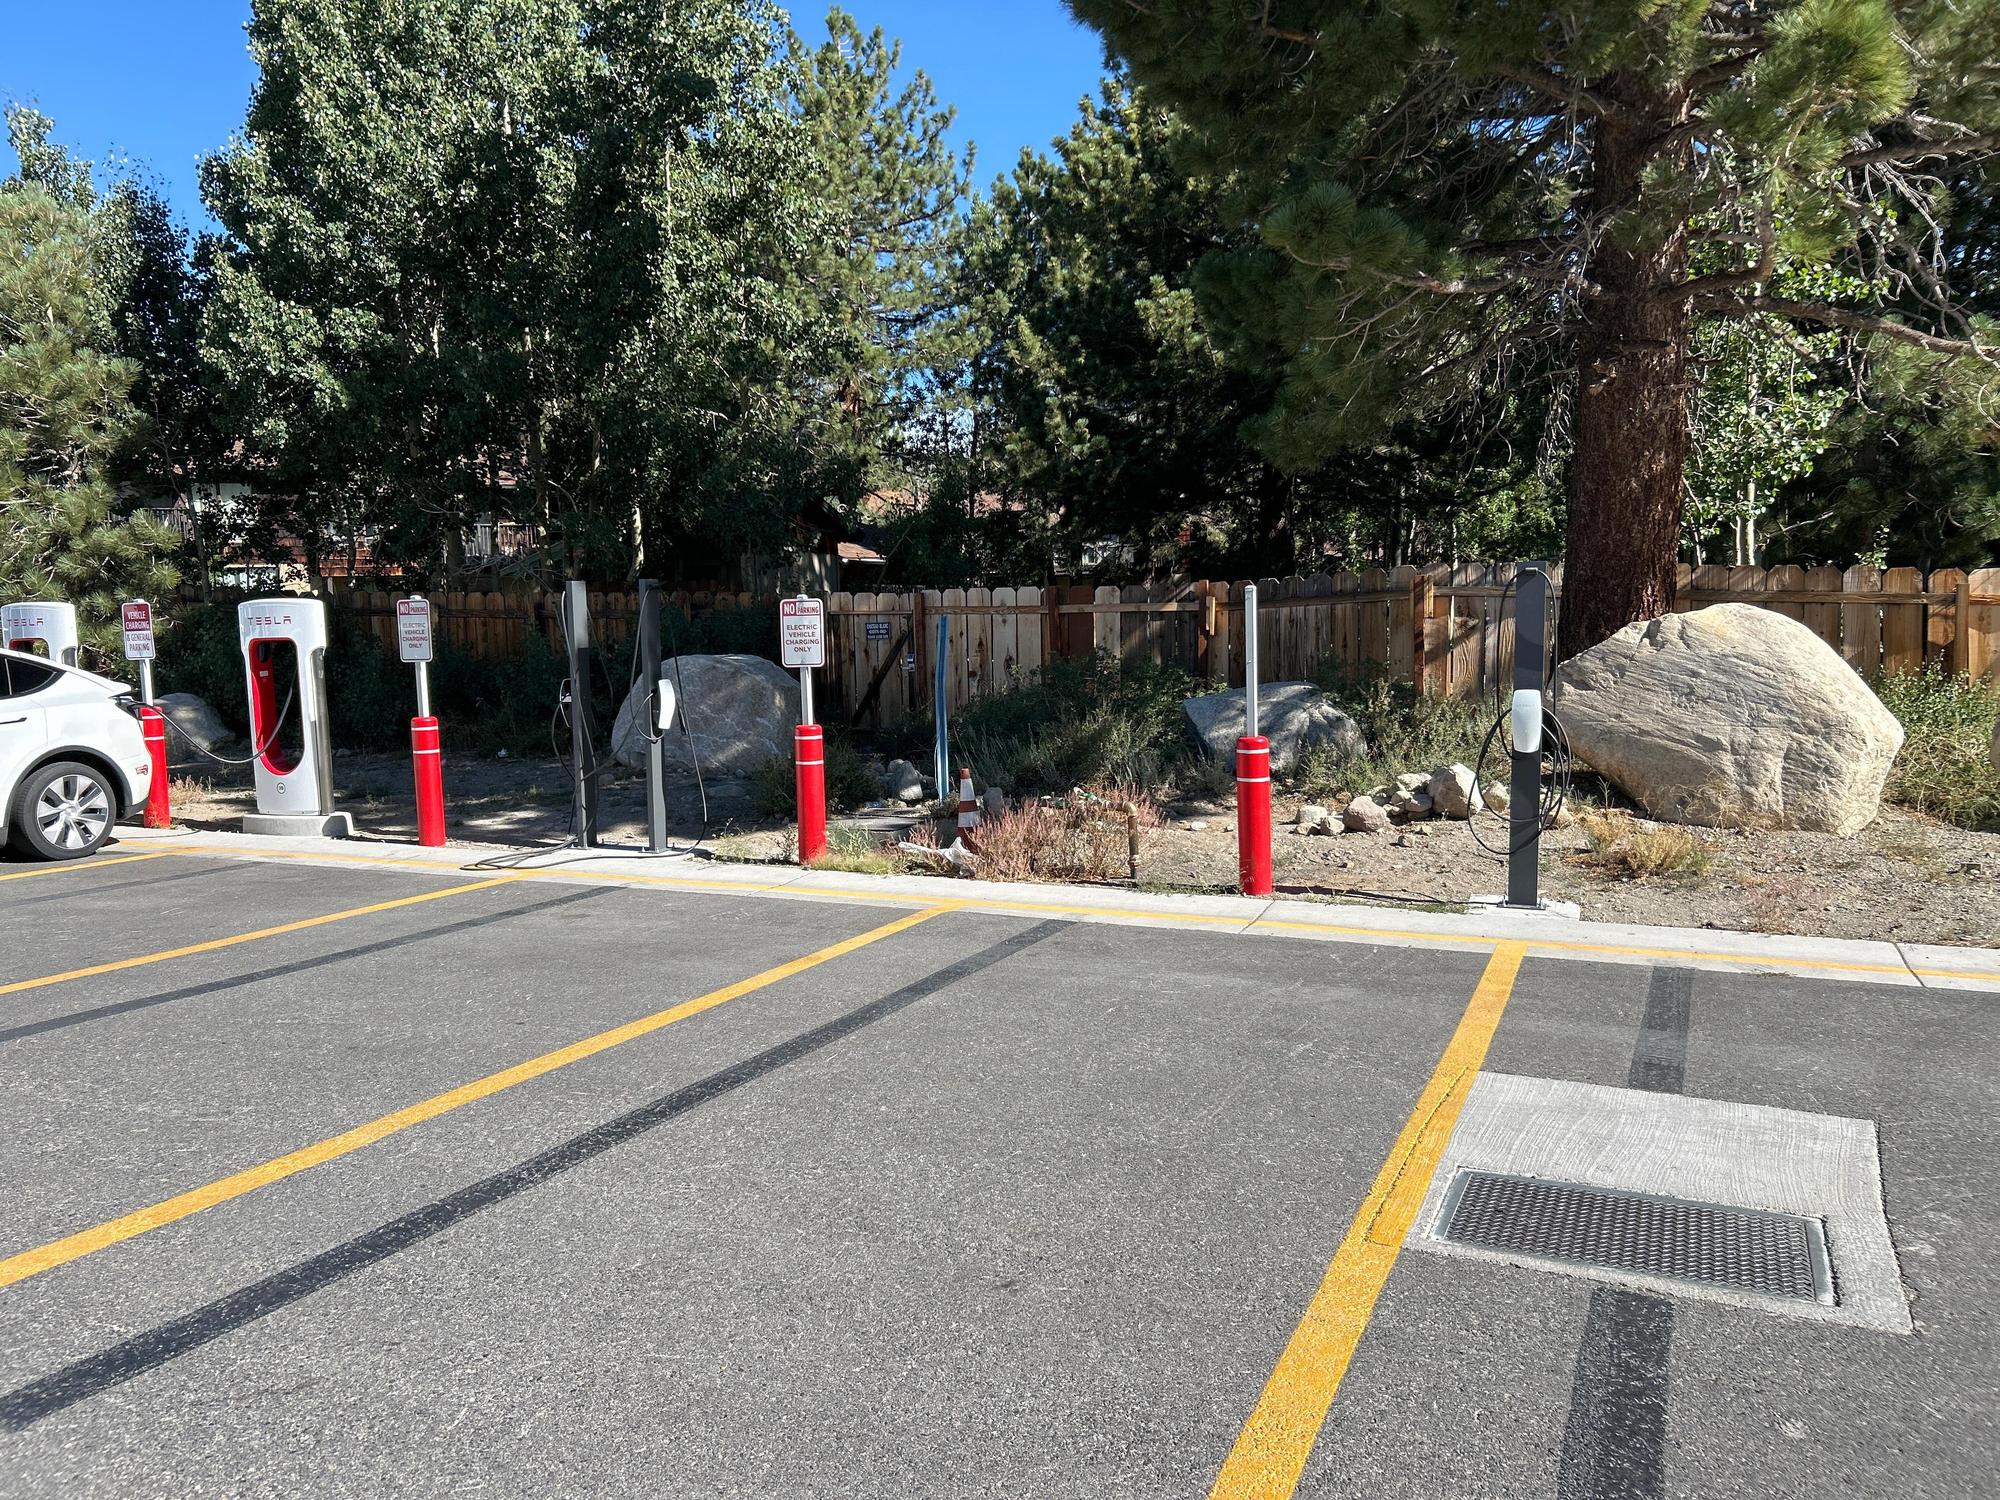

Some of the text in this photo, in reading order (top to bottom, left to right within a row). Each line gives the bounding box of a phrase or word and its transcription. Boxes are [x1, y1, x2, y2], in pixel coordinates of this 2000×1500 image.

[400, 603, 409, 614] NO
[783, 603, 819, 615] NO PARKING
[127, 611, 146, 620] VEHICLE
[248, 615, 292, 626] TESLA
[8, 617, 44, 627] TESLA
[125, 620, 150, 630] CHARGING
[131, 632, 151, 642] GENERAL
[129, 643, 150, 652] PARKING
